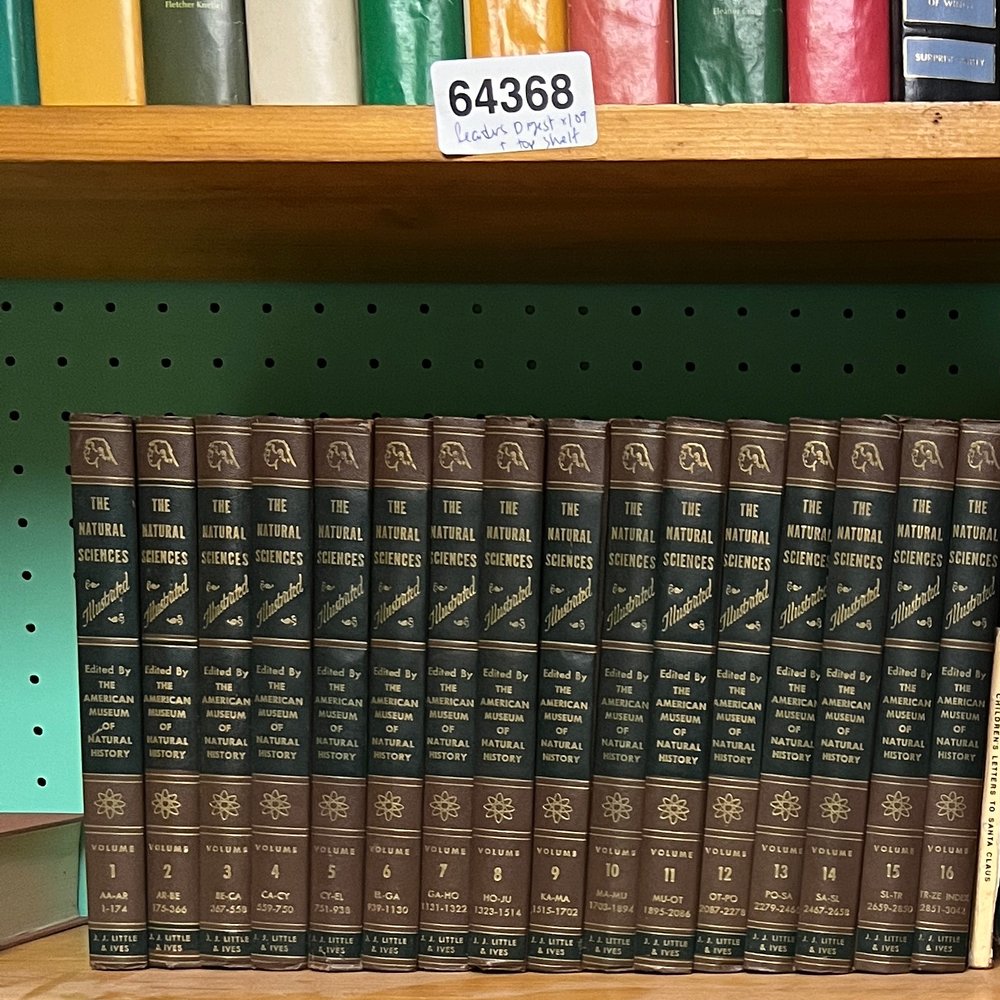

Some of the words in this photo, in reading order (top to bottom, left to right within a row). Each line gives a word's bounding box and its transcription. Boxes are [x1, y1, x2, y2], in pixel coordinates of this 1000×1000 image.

[449, 73, 574, 117] 64368
[91, 497, 110, 510] THE
[79, 523, 126, 537] NATURAL
[79, 549, 128, 563] SCIENCES
[143, 551, 188, 565] SCIENCES
[202, 552, 248, 566] SCIENCES
[256, 550, 303, 565] SCIENCES
[318, 551, 364, 567] SCIENCES
[375, 552, 421, 567] SCIENCES
[432, 552, 477, 567] SCIENCES
[485, 553, 533, 568] SCIENCES
[546, 554, 593, 569] SCIENCES
[609, 553, 656, 569] SCIENCES
[663, 553, 714, 570] SCIENCES
[724, 554, 771, 571] SCIENCES
[834, 552, 883, 570] SCIENCES
[894, 550, 942, 567] SCIENCES
[949, 551, 997, 566] SCIENCES
[83, 571, 130, 627] Illustrated
[85, 665, 114, 674] Edited
[119, 666, 131, 676] By
[99, 681, 115, 689] THE
[84, 695, 134, 703] AMERICAN
[481, 698, 529, 709] AMERICAN
[822, 698, 870, 710] AMERICAN
[89, 708, 129, 717] MUSEUM
[485, 712, 524, 722] MUSEUM
[100, 722, 115, 731] OF
[88, 734, 132, 744] NATURAL
[91, 750, 130, 758] HISTORY
[484, 753, 522, 763] HISTORY
[989, 755, 998, 797] LETTERS
[989, 801, 996, 813] TO
[987, 817, 995, 847] SANTA
[479, 848, 519, 856] VOLUME
[110, 864, 115, 878] 1
[163, 864, 171, 878] 2
[223, 865, 231, 879] 3
[271, 865, 279, 878] 4
[328, 864, 336, 878] 5
[383, 865, 391, 878] 6
[440, 864, 447, 877] 7
[551, 866, 559, 880] 9
[606, 863, 619, 877] 10
[775, 864, 787, 878] 13
[887, 864, 900, 878] 15
[941, 865, 953, 879] 16
[984, 851, 993, 882] CLAUS
[494, 867, 502, 881] 8
[665, 868, 675, 882] 11
[718, 867, 731, 881] 12
[823, 867, 836, 881] 14
[484, 894, 511, 903] HO-JU
